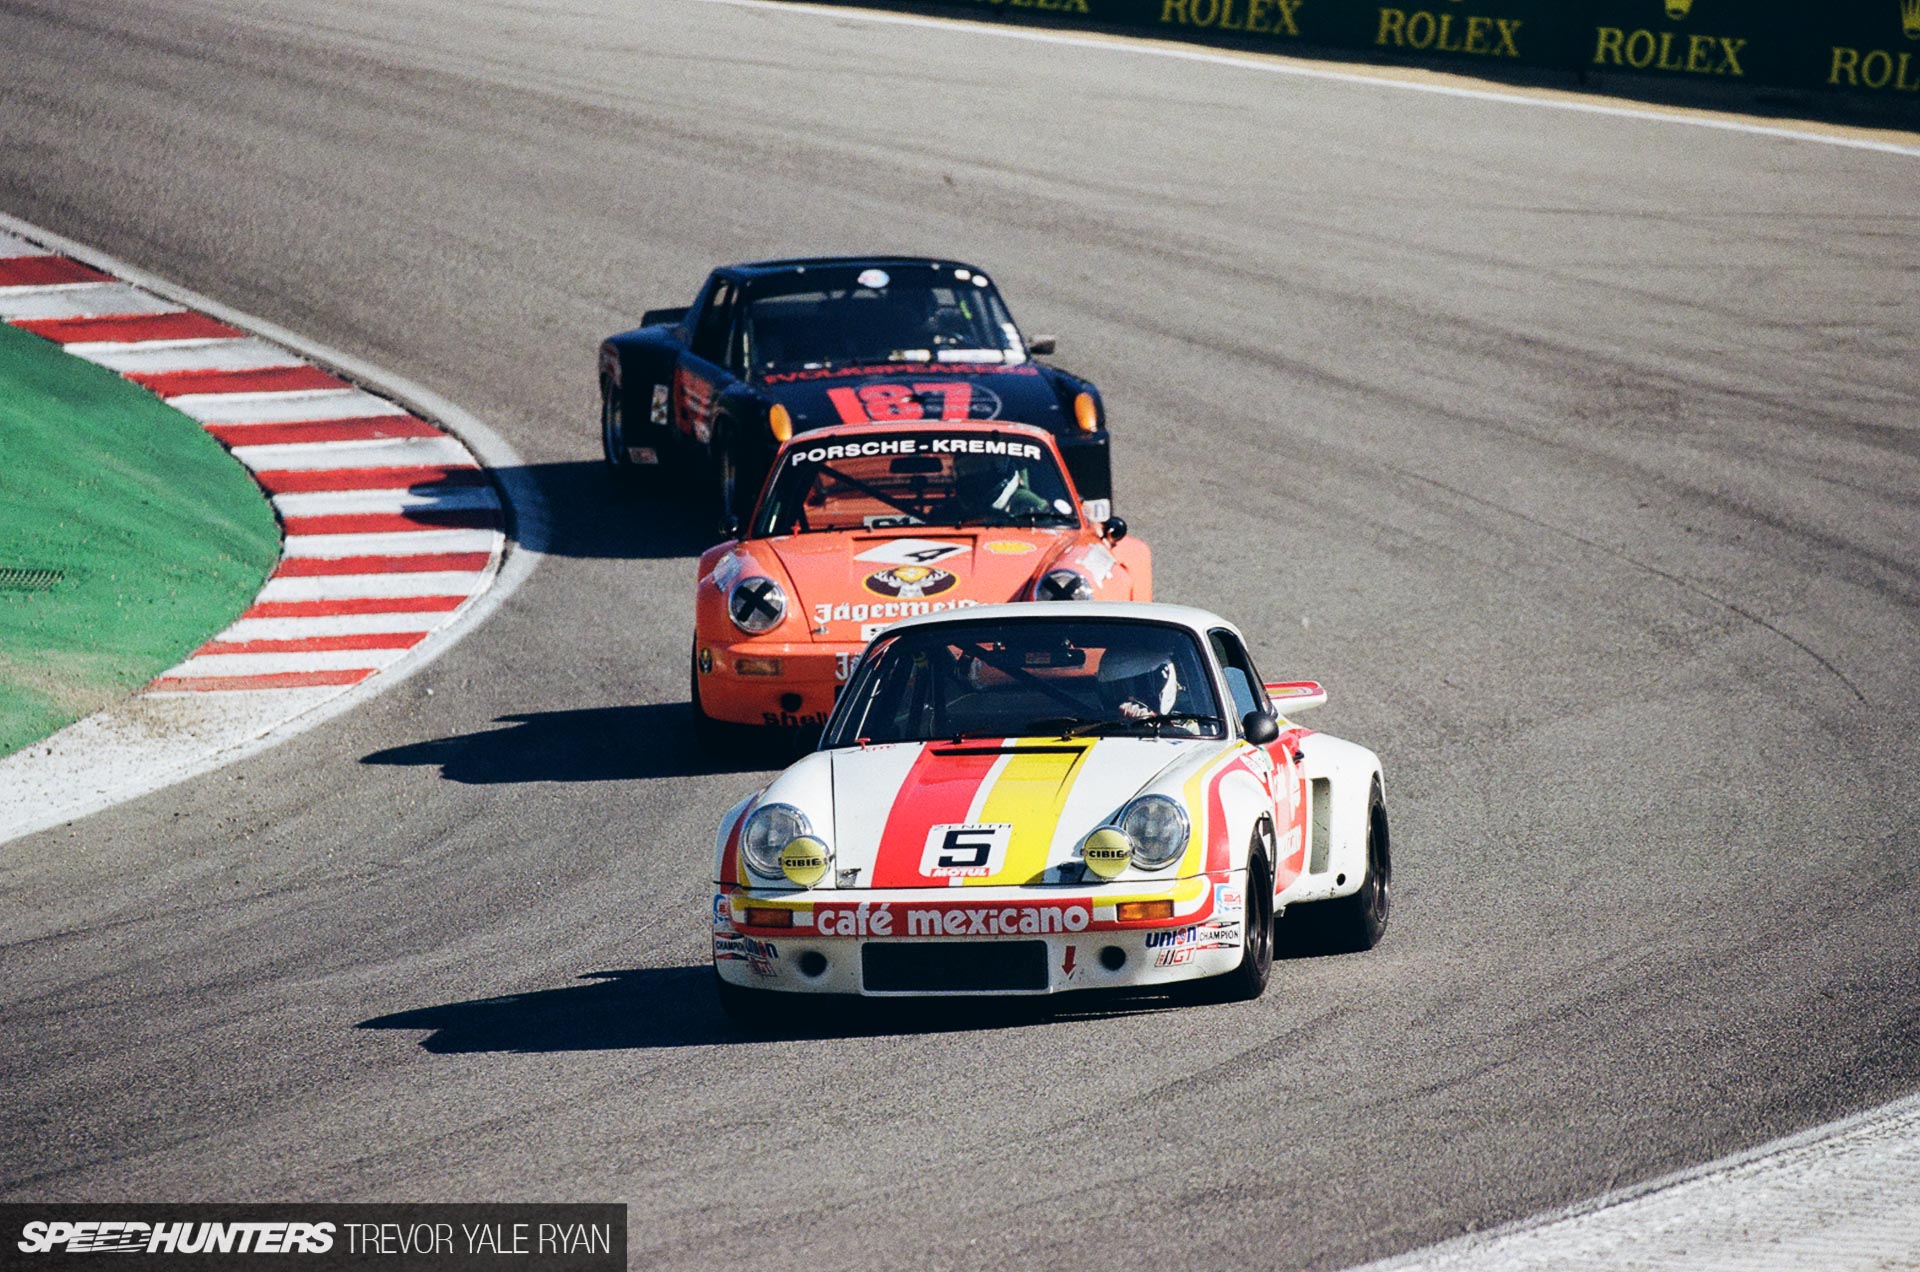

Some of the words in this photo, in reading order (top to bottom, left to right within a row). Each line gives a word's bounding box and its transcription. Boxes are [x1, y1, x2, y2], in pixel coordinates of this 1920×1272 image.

[1376, 7, 1521, 56] ROLEX
[1593, 26, 1747, 76] ROLEX
[904, 547, 960, 562] 4
[938, 829, 996, 867] 5
[932, 868, 989, 877] MOTUL
[817, 901, 894, 936] café
[907, 905, 1090, 935] mexicano
[1200, 929, 1239, 941] CHAMPION
[1173, 947, 1196, 963] GT
